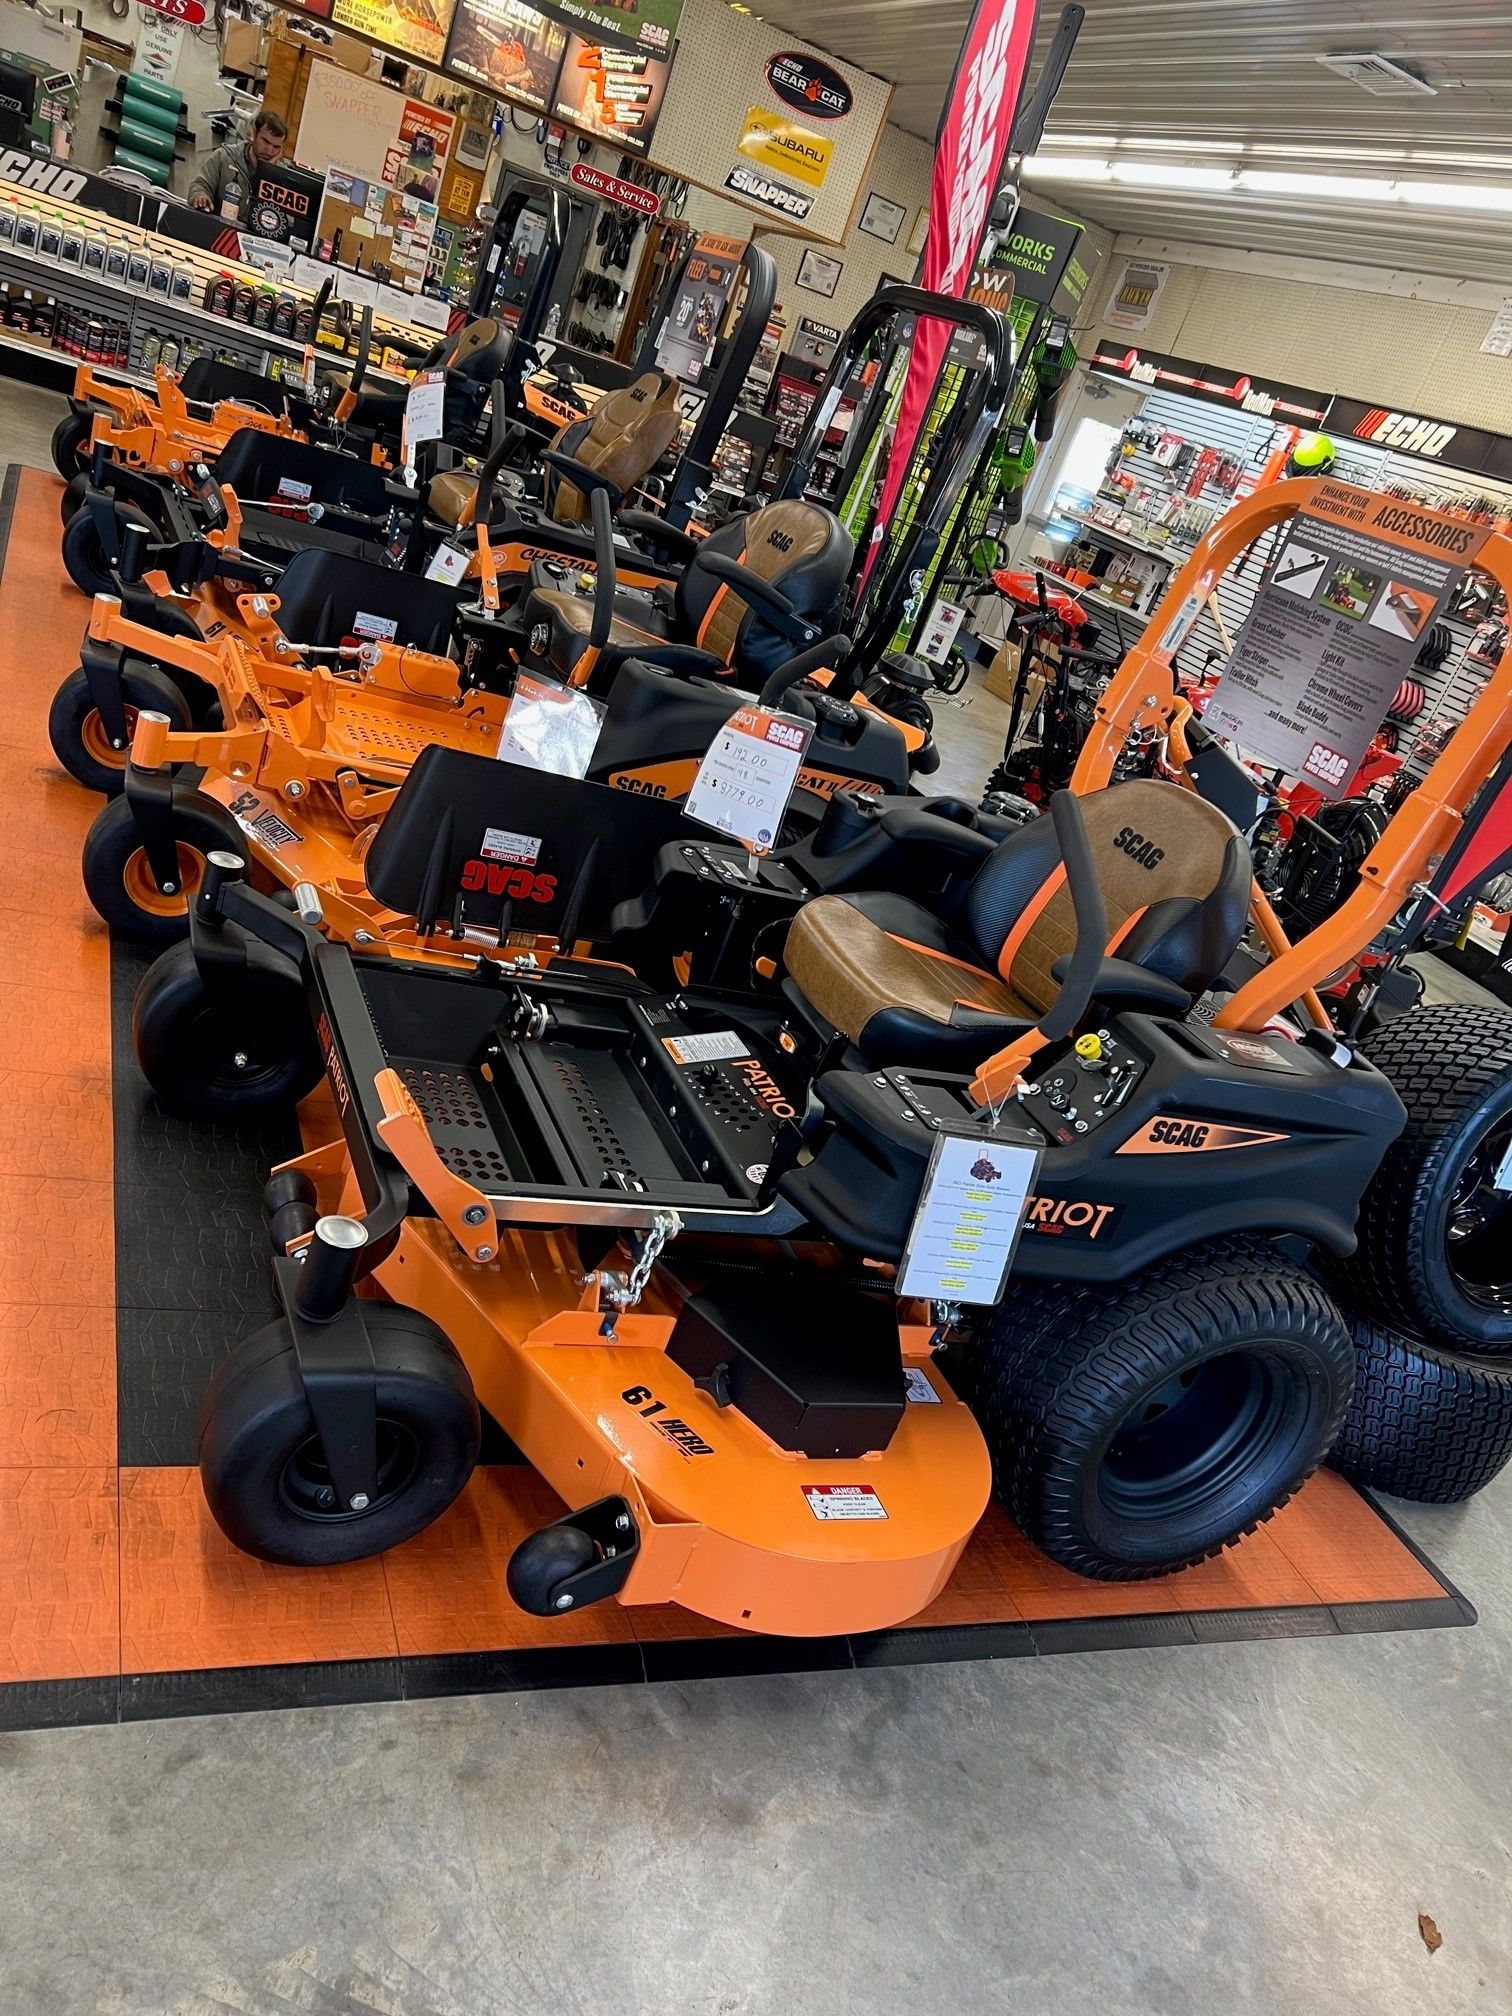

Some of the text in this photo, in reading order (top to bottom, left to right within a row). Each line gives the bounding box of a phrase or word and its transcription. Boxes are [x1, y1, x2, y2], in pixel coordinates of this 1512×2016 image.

[558, 0, 587, 19] Simply
[587, 10, 604, 25] The
[155, 34, 168, 44] USE
[161, 26, 178, 37] ONLY
[640, 22, 670, 41] SCAG
[146, 40, 173, 57] GENUINE
[143, 68, 164, 81] PARTS
[782, 58, 804, 73] ECHO
[772, 66, 845, 109] BEAR CAT
[768, 130, 825, 164] SUBARU
[0, 148, 88, 201] CHO
[260, 182, 309, 214] SCAG
[576, 168, 655, 210] Sales & Service
[730, 168, 805, 217] SNAPPER
[813, 324, 838, 340] VARTA
[630, 387, 648, 404] SCAG
[541, 396, 577, 421] SCAG
[1370, 412, 1457, 458] ECHO
[1319, 484, 1370, 508] ENHANCE YOUR
[1308, 495, 1366, 523] INVESTMENT WITH
[767, 529, 794, 553] SCAG
[1371, 505, 1475, 554] ACCESSORIES
[1263, 590, 1290, 610] Hurricane
[1288, 601, 1313, 621] Mulching
[1310, 609, 1333, 628] System
[1250, 617, 1266, 632] Grass
[1262, 622, 1288, 640] Catcher
[1239, 644, 1253, 660] Tiger
[1250, 649, 1270, 666] Striper
[1321, 649, 1336, 665] Light
[1334, 655, 1345, 667] Kit
[1228, 666, 1259, 688] Trailer Hitch
[1307, 678, 1330, 695] Chrome
[1327, 685, 1347, 704] Wheel
[1343, 695, 1364, 713] Covers
[1276, 713, 1293, 729] many
[1290, 719, 1309, 735] more!
[1296, 700, 1312, 716] Blade
[1310, 706, 1330, 725] Buddy
[766, 733, 783, 745] POWER
[768, 722, 804, 743] SCAG
[724, 742, 730, 751] $
[1307, 745, 1349, 777] SCAG
[615, 776, 667, 799] SCAG
[711, 779, 718, 788] $
[228, 790, 305, 846] 52 VELOCITY
[488, 849, 519, 864] DANGER
[1112, 826, 1165, 871] SCAG
[461, 859, 558, 903] SCAG
[327, 1045, 349, 1118] PATRIOT
[730, 1059, 800, 1119] PATRIO
[1149, 1120, 1210, 1149] SCAG
[1036, 1222, 1065, 1235] SCAG
[620, 1384, 716, 1457] 61 HERO
[829, 1485, 863, 1496] DANGER
